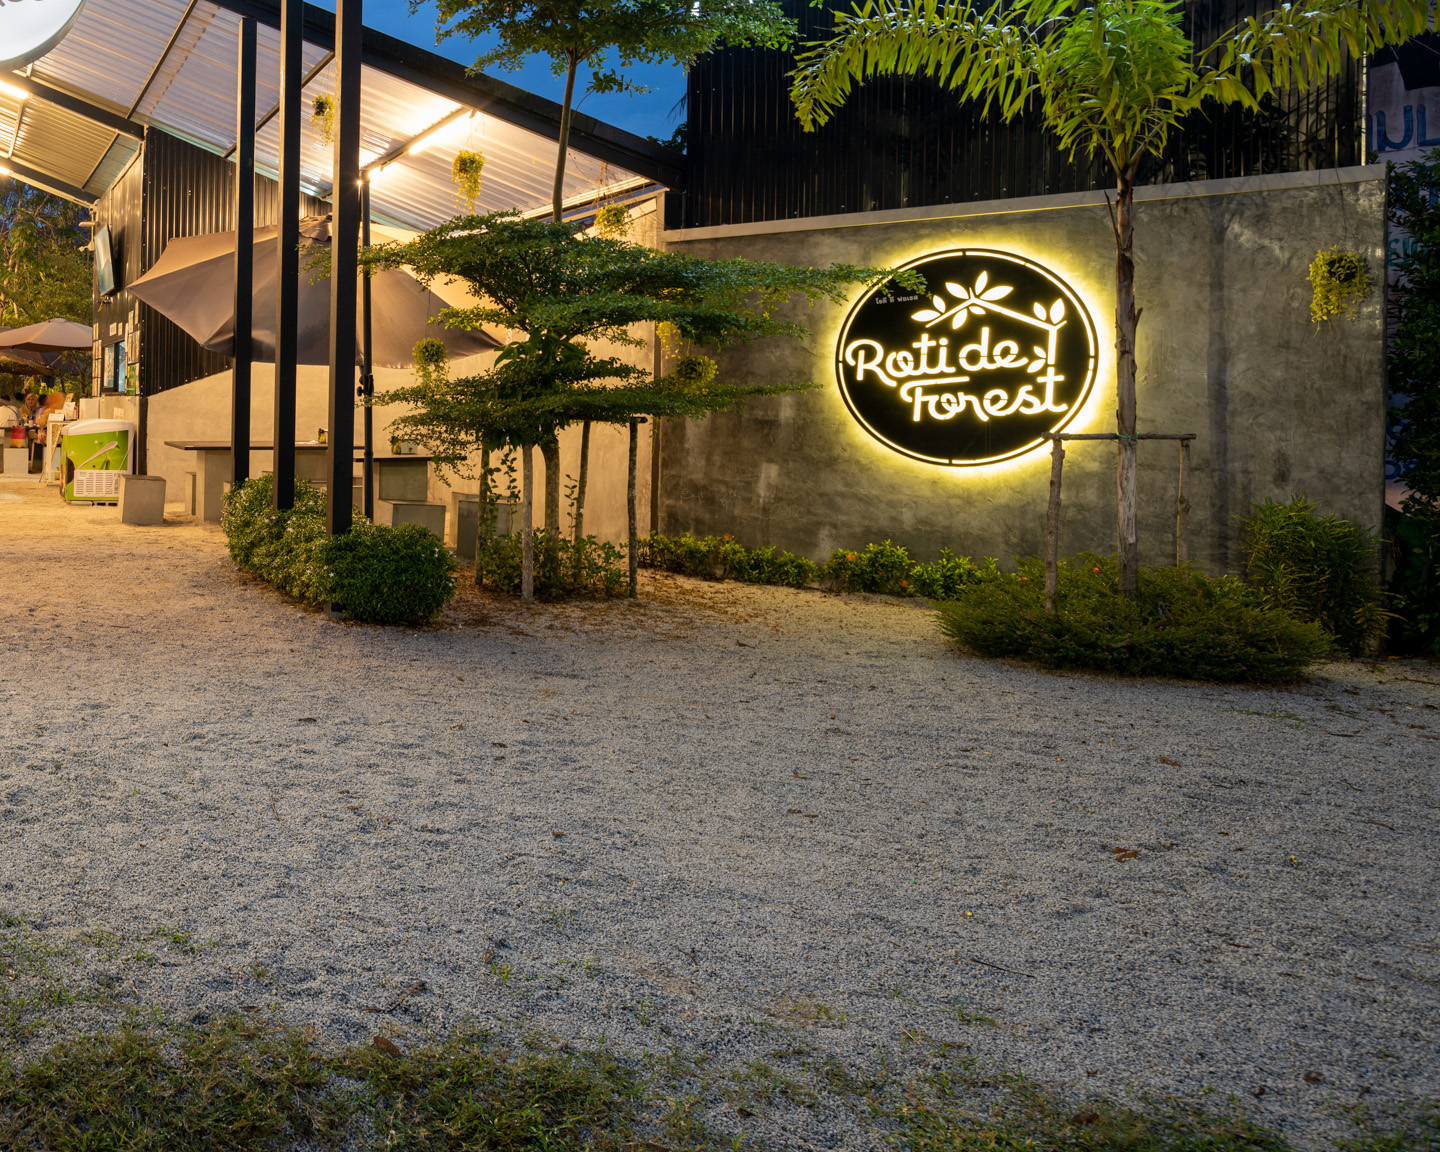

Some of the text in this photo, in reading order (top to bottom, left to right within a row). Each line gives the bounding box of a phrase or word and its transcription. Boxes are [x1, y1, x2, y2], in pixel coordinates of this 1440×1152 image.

[845, 326, 1029, 388] Roti de
[900, 365, 1068, 422] Forest
